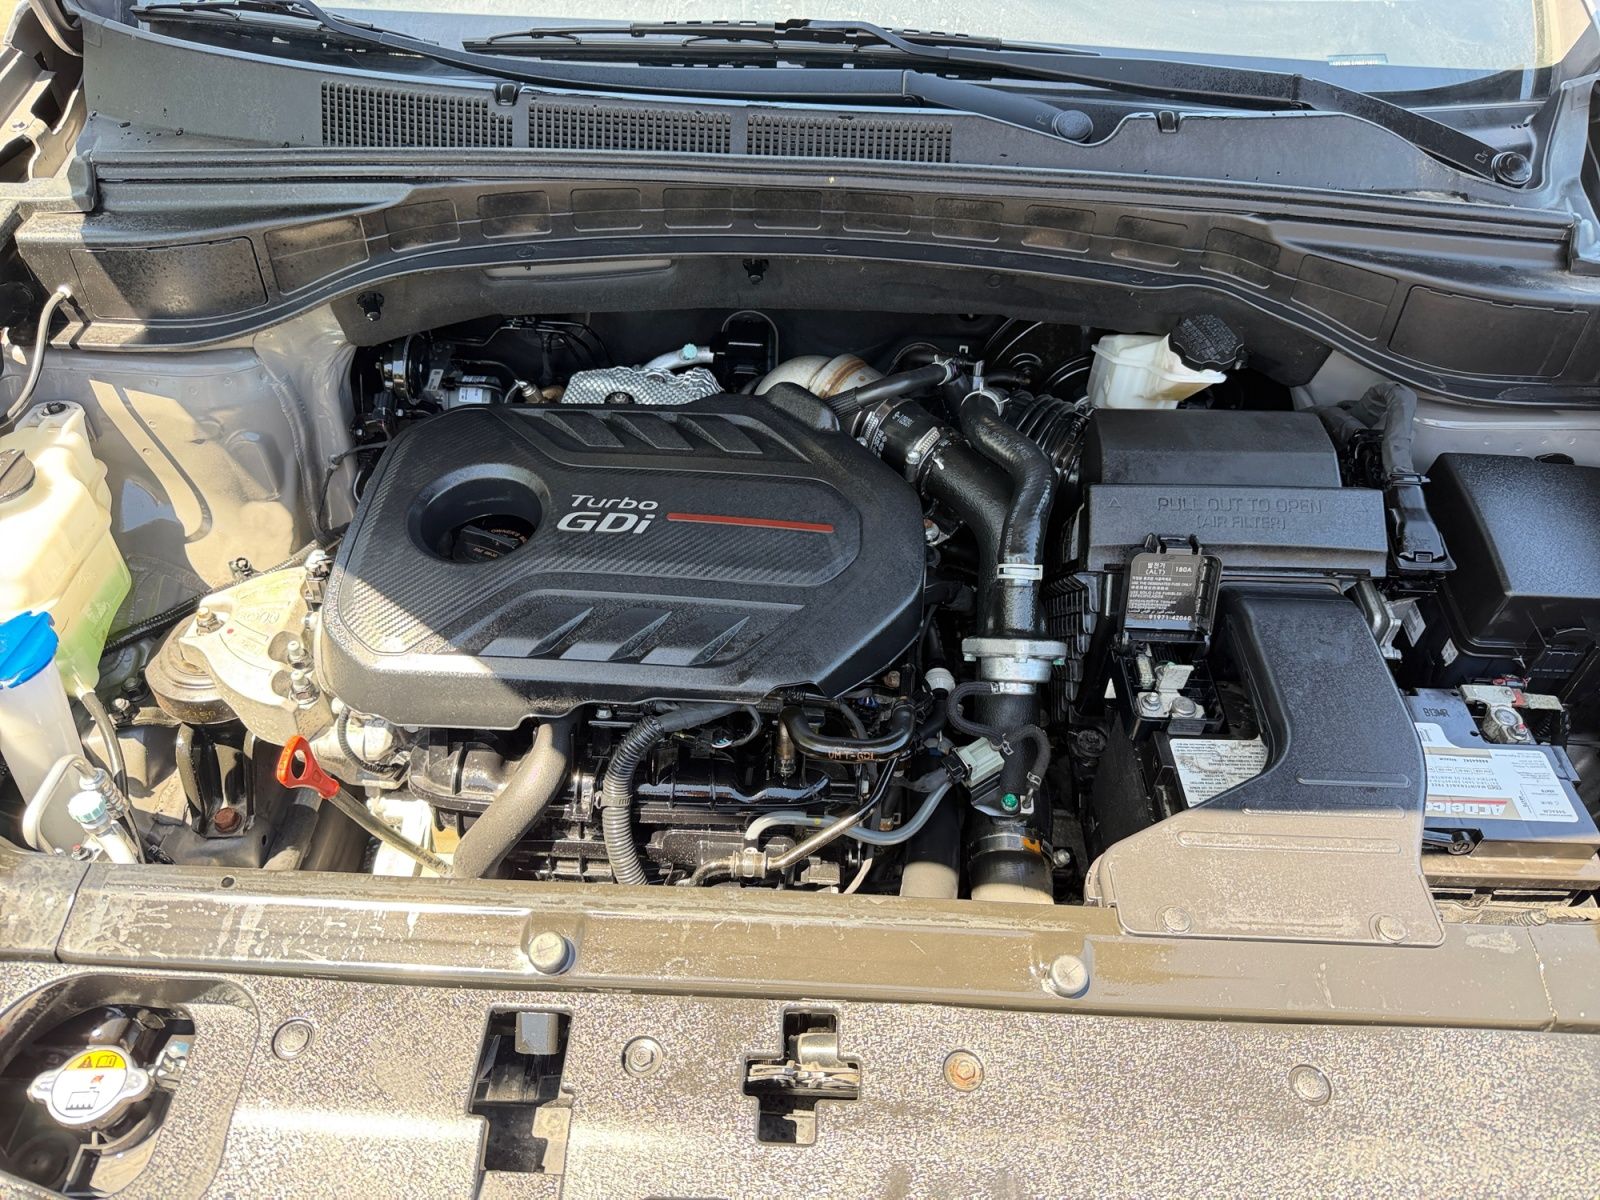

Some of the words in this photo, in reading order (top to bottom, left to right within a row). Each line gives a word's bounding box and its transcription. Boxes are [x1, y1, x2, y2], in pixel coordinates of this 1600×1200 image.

[571, 494, 659, 511] Turbo
[1157, 497, 1200, 512] PULL
[1207, 498, 1243, 513] OUT
[1247, 499, 1271, 513] TO
[1275, 500, 1322, 514] OPEN
[556, 511, 656, 534] GDi
[1196, 514, 1227, 529] (AIR
[1231, 516, 1286, 530] FILTER)
